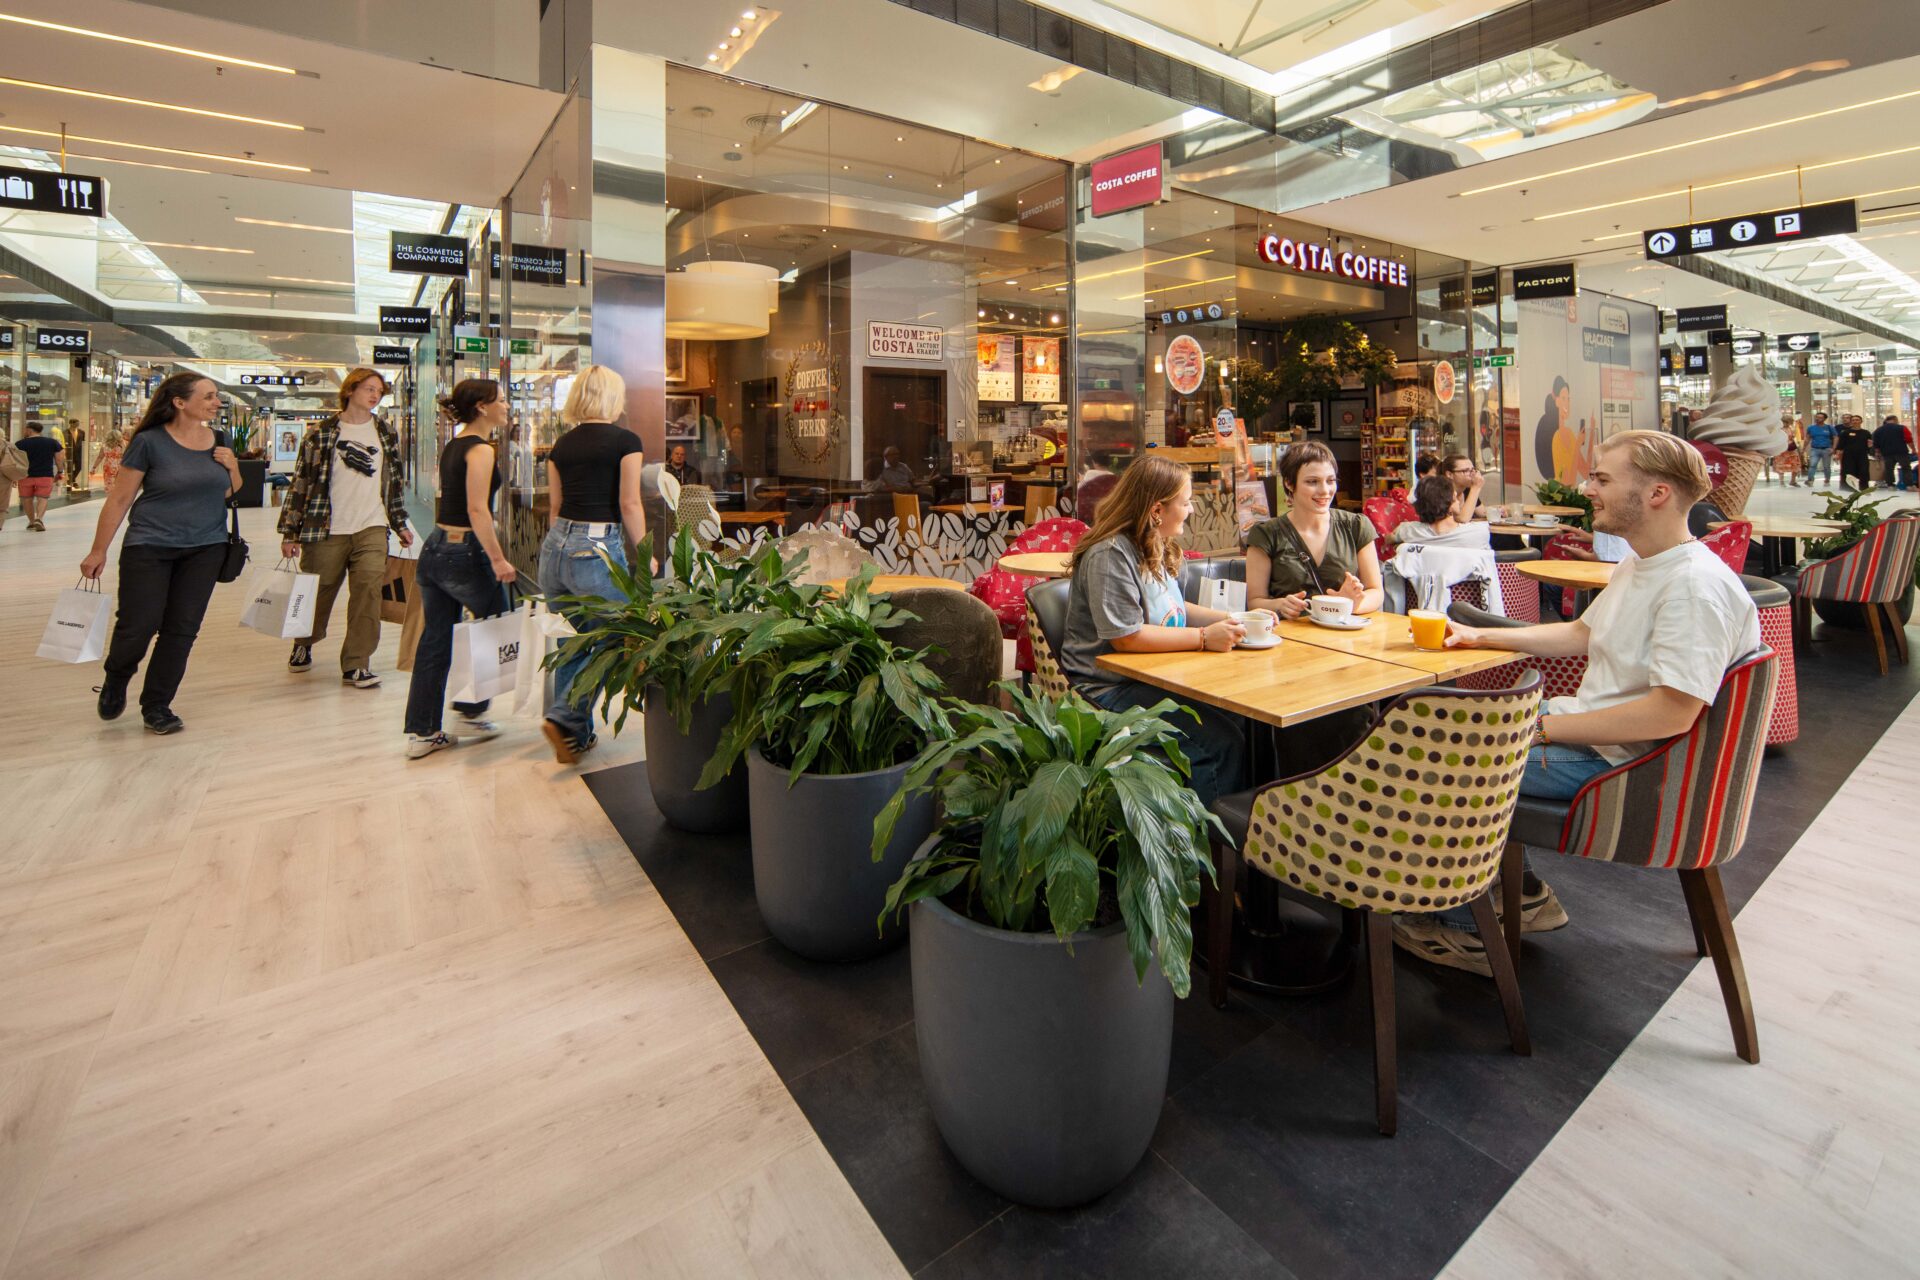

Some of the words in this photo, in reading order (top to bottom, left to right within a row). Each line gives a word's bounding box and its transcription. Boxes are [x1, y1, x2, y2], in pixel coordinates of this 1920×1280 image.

[1096, 178, 1123, 192] COSTA
[1124, 167, 1158, 184] COFFEE
[396, 244, 413, 253] THE
[416, 246, 464, 257] COSMETICS
[396, 252, 438, 263] COMPANY
[440, 255, 464, 265] STORE
[1263, 234, 1334, 273] COSTA
[1340, 251, 1408, 287] COFFEE
[1517, 276, 1571, 288] FACTORY
[382, 316, 427, 324] FACTORY
[39, 334, 86, 346] BOSS
[872, 326, 925, 341] WELCOME
[927, 331, 940, 341] TO
[872, 339, 914, 354] COSTA
[375, 351, 394, 359] Calvin
[394, 352, 408, 360] Klein
[796, 367, 827, 390] COFFEE
[798, 418, 826, 438] PERKS
